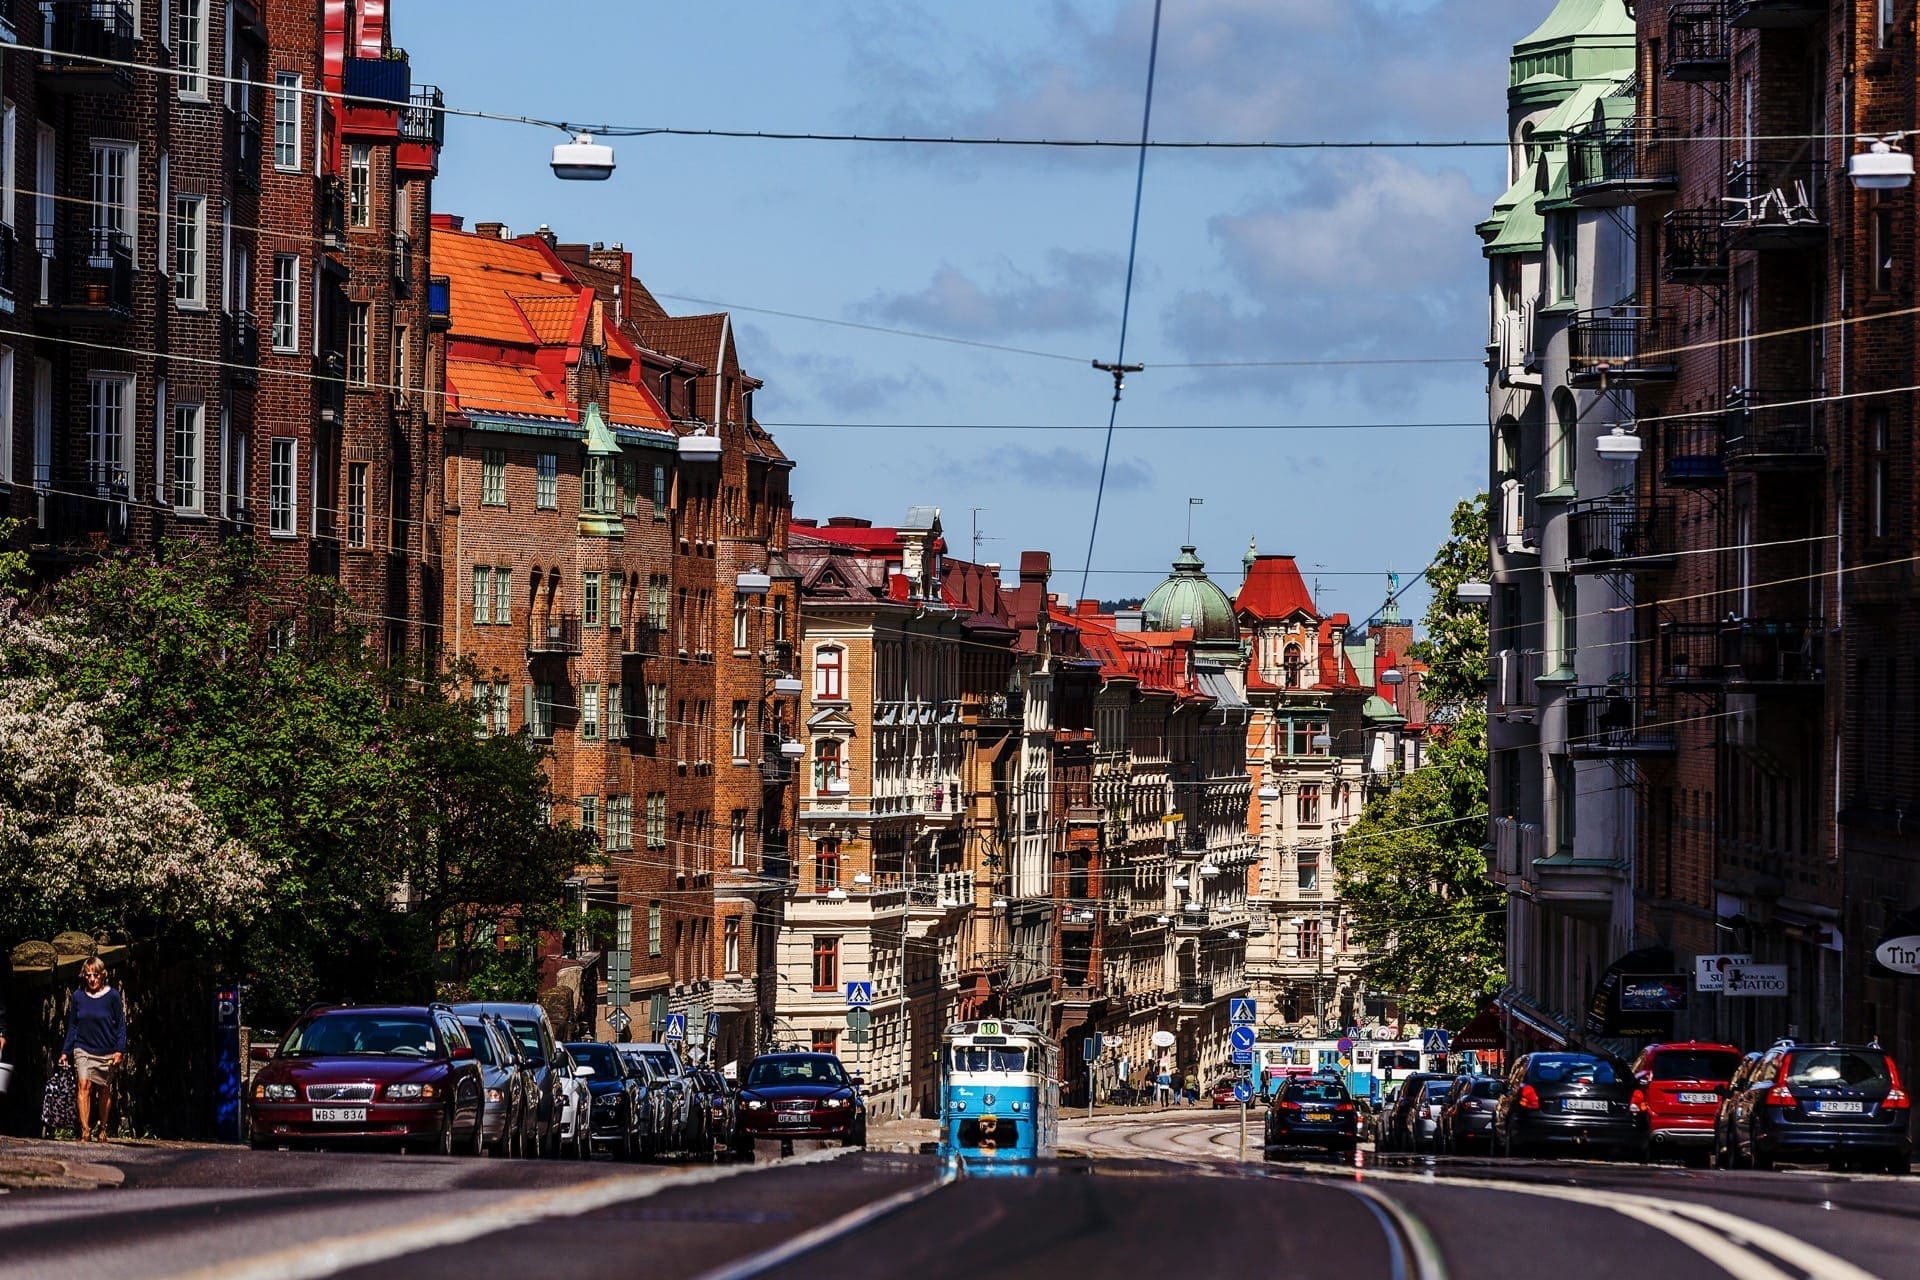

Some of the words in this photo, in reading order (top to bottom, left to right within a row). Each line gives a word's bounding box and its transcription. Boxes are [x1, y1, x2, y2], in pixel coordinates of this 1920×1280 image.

[1743, 980, 1785, 990] TATTOO
[1624, 984, 1664, 997] Smart
[218, 1001, 235, 1022] P
[984, 1023, 996, 1034] 10
[1844, 1102, 1861, 1111] 735
[315, 1110, 335, 1120] WBS
[343, 1110, 364, 1120] 834
